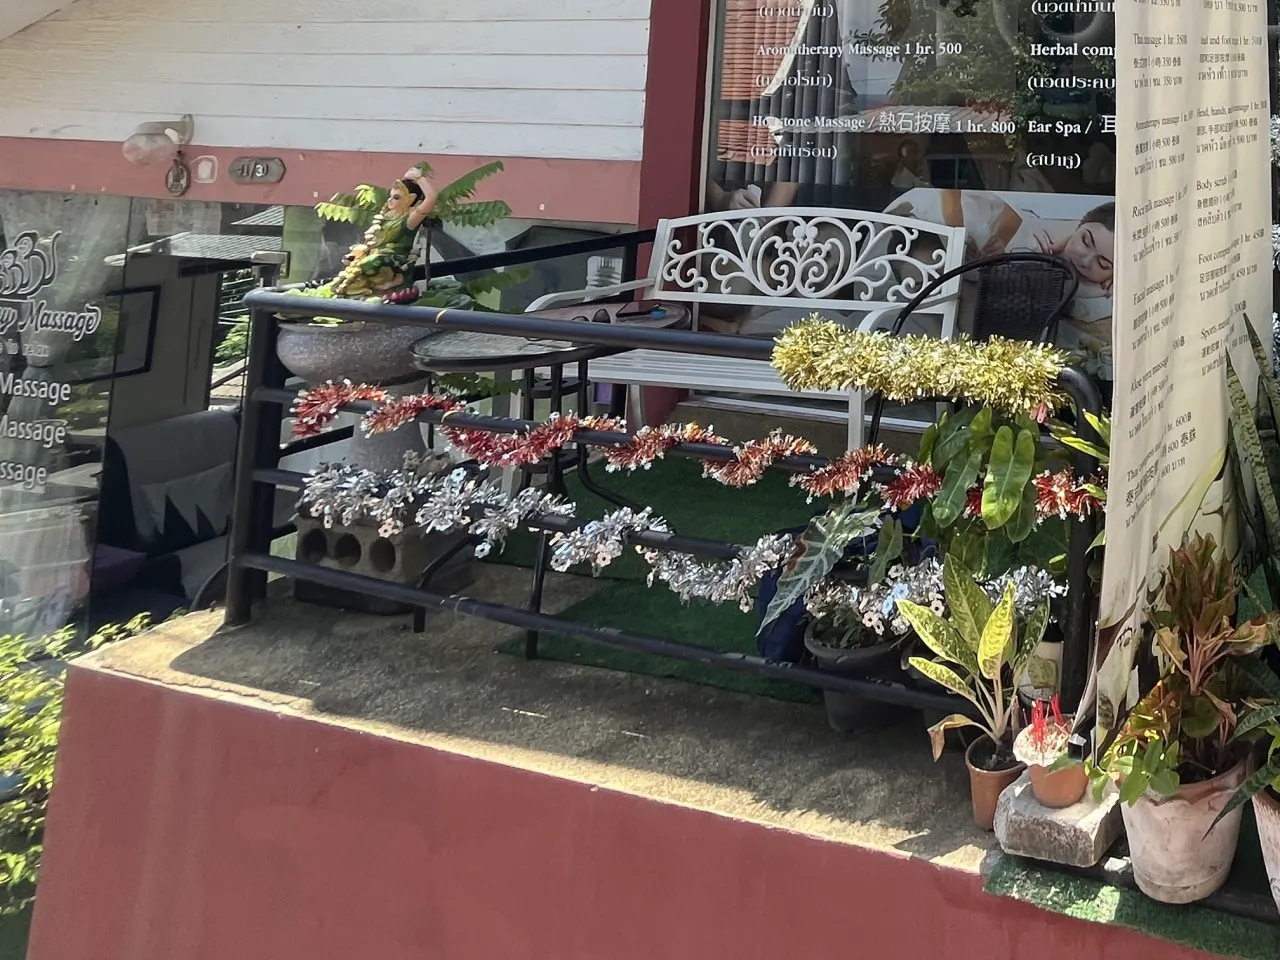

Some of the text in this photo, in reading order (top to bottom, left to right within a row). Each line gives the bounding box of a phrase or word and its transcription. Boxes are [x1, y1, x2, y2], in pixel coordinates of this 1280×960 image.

[848, 43, 900, 57] Massage
[904, 42, 910, 54] 1
[916, 42, 934, 54] hr.
[939, 42, 962, 54] 500
[1030, 43, 1078, 56] Herbal
[781, 116, 811, 127] stone
[814, 116, 865, 131] Massage
[879, 112, 951, 133] 熱石按摩
[956, 120, 962, 132] 1
[967, 120, 987, 132] hr.
[991, 121, 1015, 133] 800
[1028, 121, 1051, 133] Ear
[1055, 121, 1081, 136] Spa
[1026, 152, 1081, 169] (สปาหู)
[1196, 178, 1211, 191] Body
[18, 300, 101, 341] Massage
